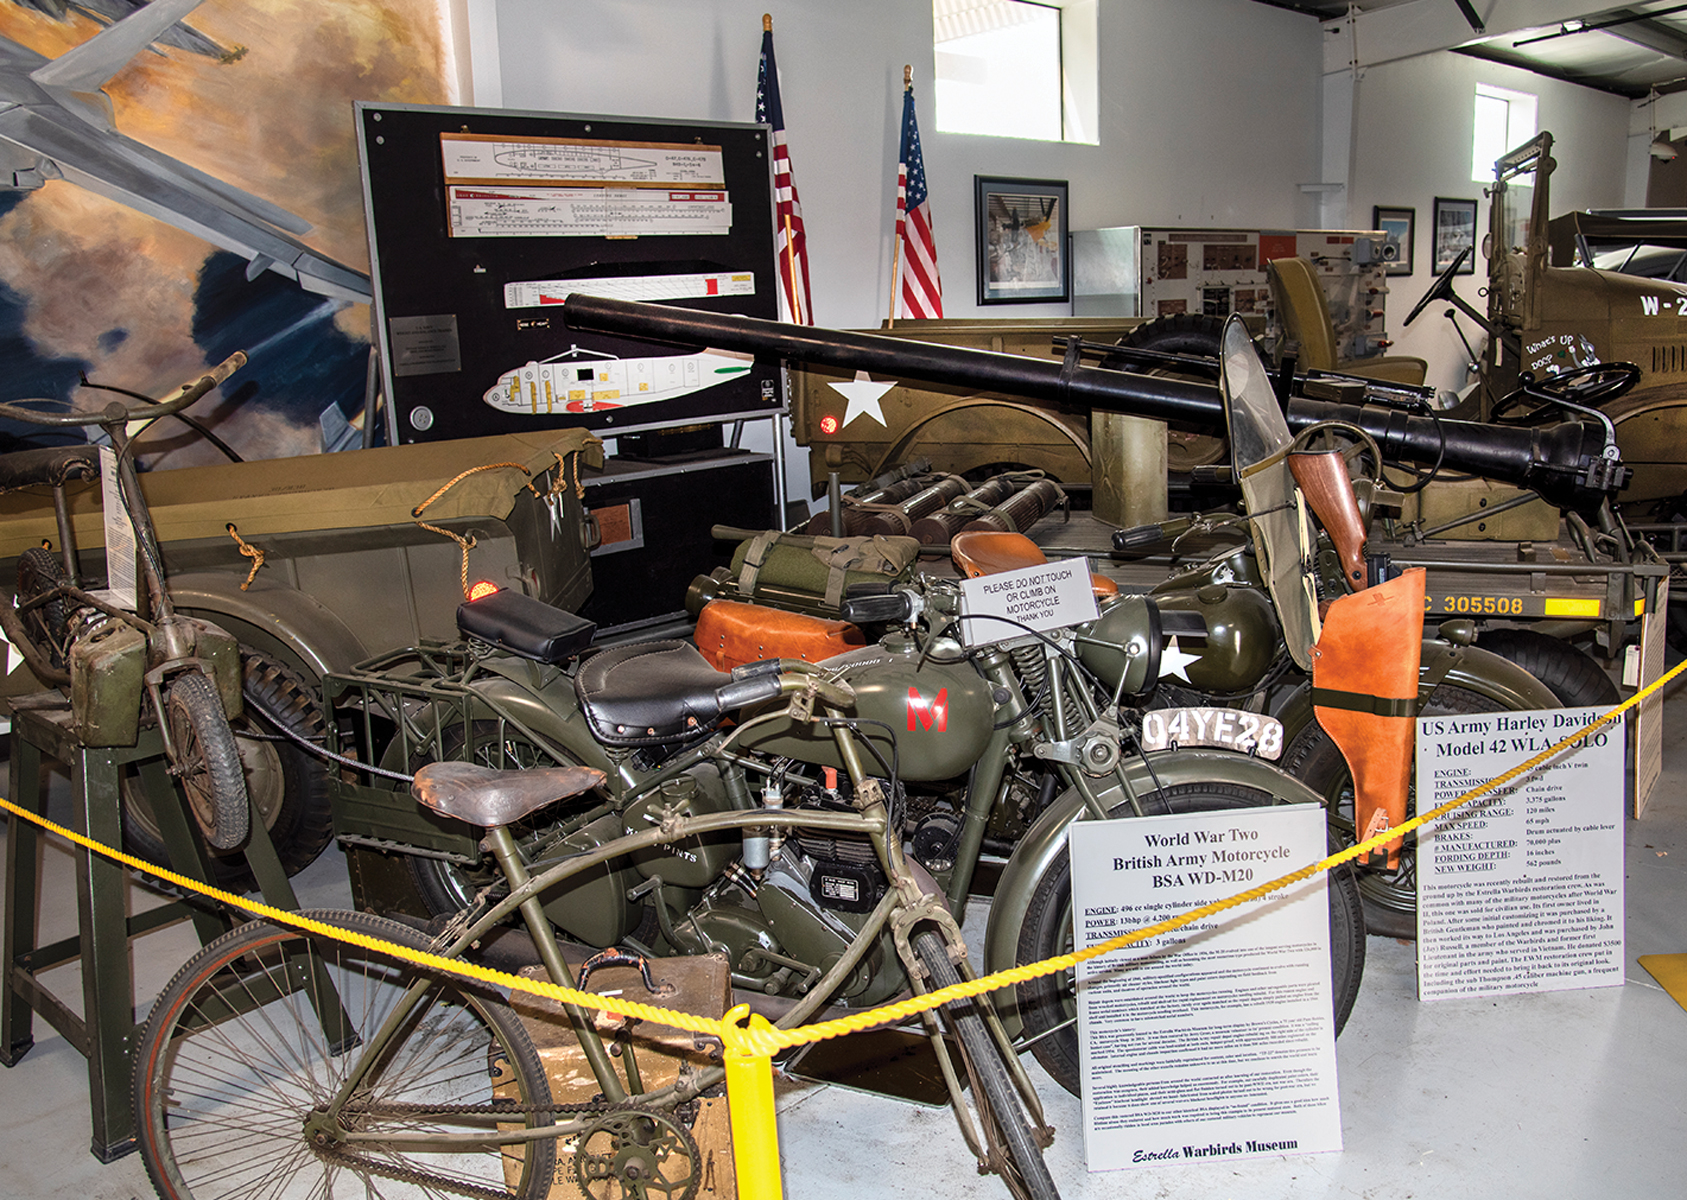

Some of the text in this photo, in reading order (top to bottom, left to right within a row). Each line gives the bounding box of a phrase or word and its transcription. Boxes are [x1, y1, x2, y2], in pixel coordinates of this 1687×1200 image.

[1559, 335, 1574, 346] UP
[983, 570, 1073, 594] PLEASE DO NOT TOUCH
[1006, 585, 1056, 602] OR CLIMB ON
[1006, 596, 1060, 614] MOTORCYCLE
[1443, 597, 1523, 615] 305508
[1016, 609, 1054, 623] THANK YOU
[907, 686, 949, 733] M
[1422, 721, 1444, 736] US
[1449, 719, 1492, 734] Army
[1496, 716, 1548, 732] Harley
[1436, 741, 1485, 757] Model
[1489, 740, 1507, 754] 42
[1434, 768, 1472, 778] ENGINE:
[1479, 808, 1515, 818] RANGE:
[1434, 820, 1489, 833] MAX SPEED:
[1535, 817, 1550, 825] mph
[1546, 826, 1573, 834] actuated
[1573, 825, 1581, 833] by
[1582, 824, 1599, 832] cable
[1144, 828, 1259, 848] World War Two
[1434, 832, 1473, 842] BRAKES:
[663, 843, 698, 863] PINTS
[1113, 846, 1291, 871] British Army Motorcycle
[1434, 851, 1511, 863] FORDING DEPTH:
[1434, 862, 1497, 874] NEW WEIGHT:
[1538, 859, 1562, 867] pounds
[1152, 868, 1254, 889] BSA WD-M20
[1438, 881, 1472, 889] motorcycle
[1422, 892, 1445, 900] ground
[1530, 892, 1566, 900] motorcycles
[1085, 906, 1119, 916] ENGINE:
[1143, 903, 1163, 911] single
[1164, 901, 1193, 910] cylinder
[1085, 918, 1118, 928] POWER:
[1162, 938, 1186, 946] gallons
[1131, 1139, 1298, 1163] Estrella Warbirds Museum
